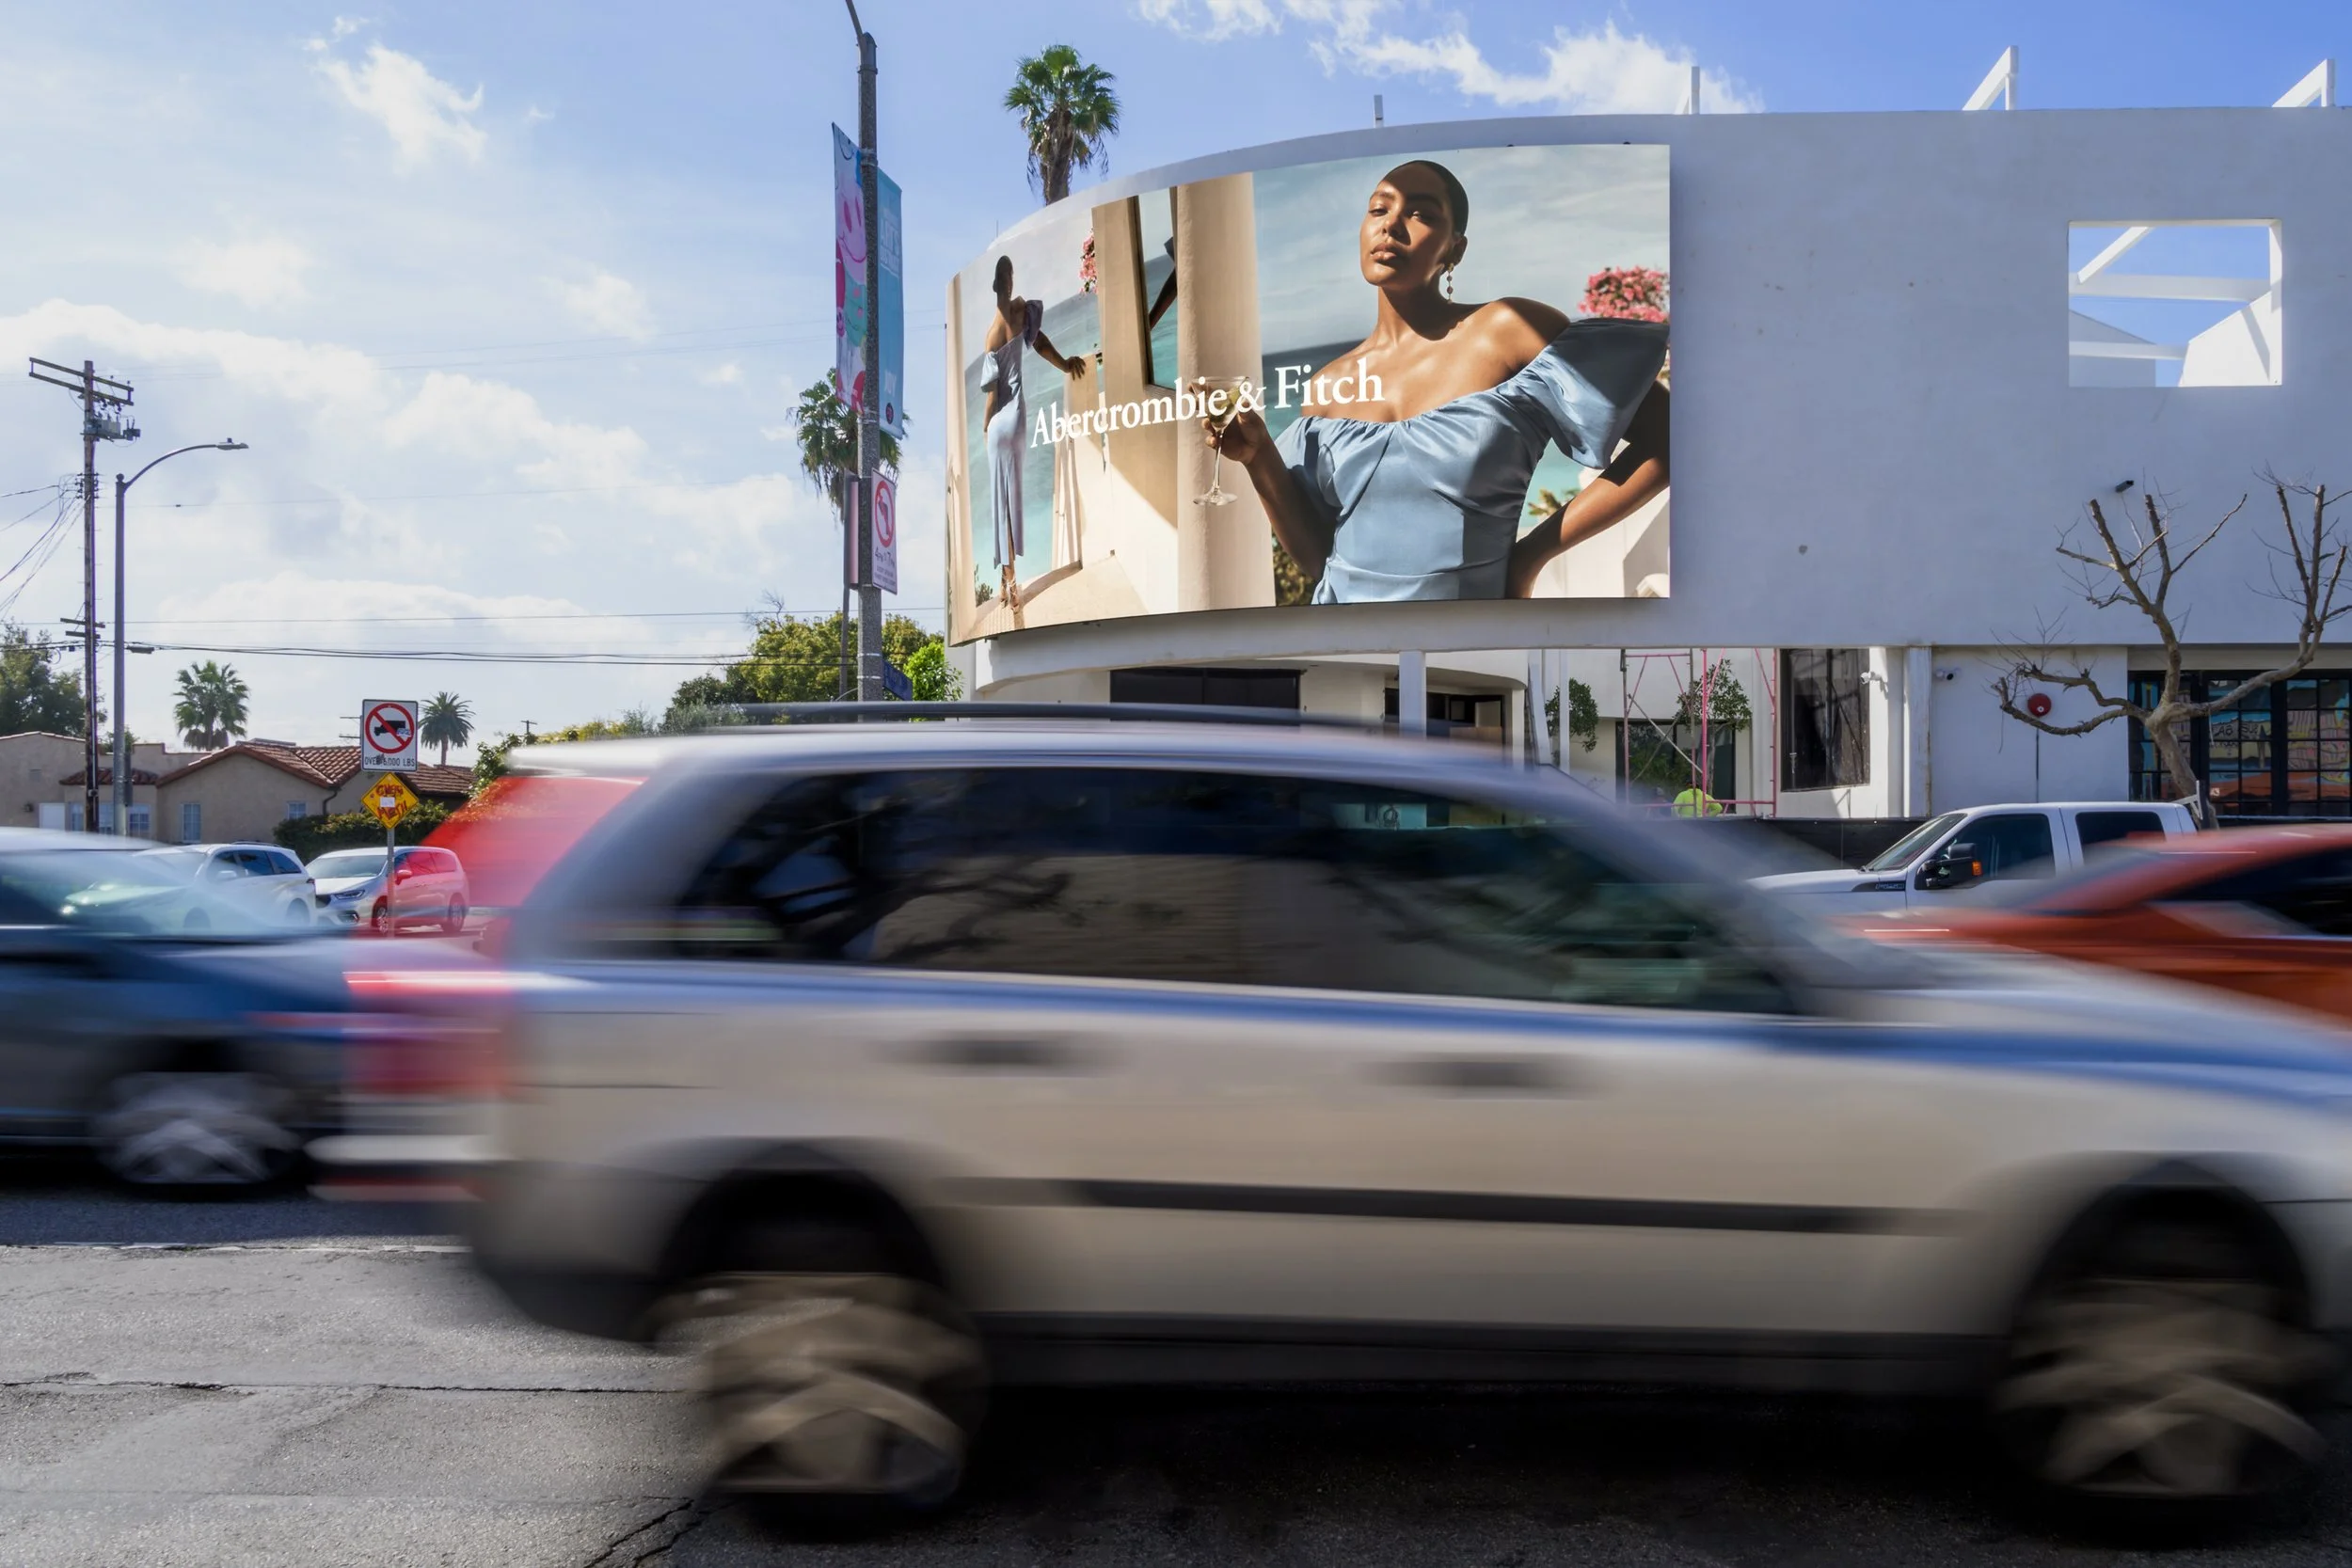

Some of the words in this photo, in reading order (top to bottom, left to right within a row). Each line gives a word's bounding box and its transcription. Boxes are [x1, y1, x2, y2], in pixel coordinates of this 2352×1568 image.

[1030, 375, 1228, 449] Abercrombie
[1236, 380, 1266, 413] &
[1274, 356, 1385, 409] Fitch
[403, 758, 416, 768] LBS
